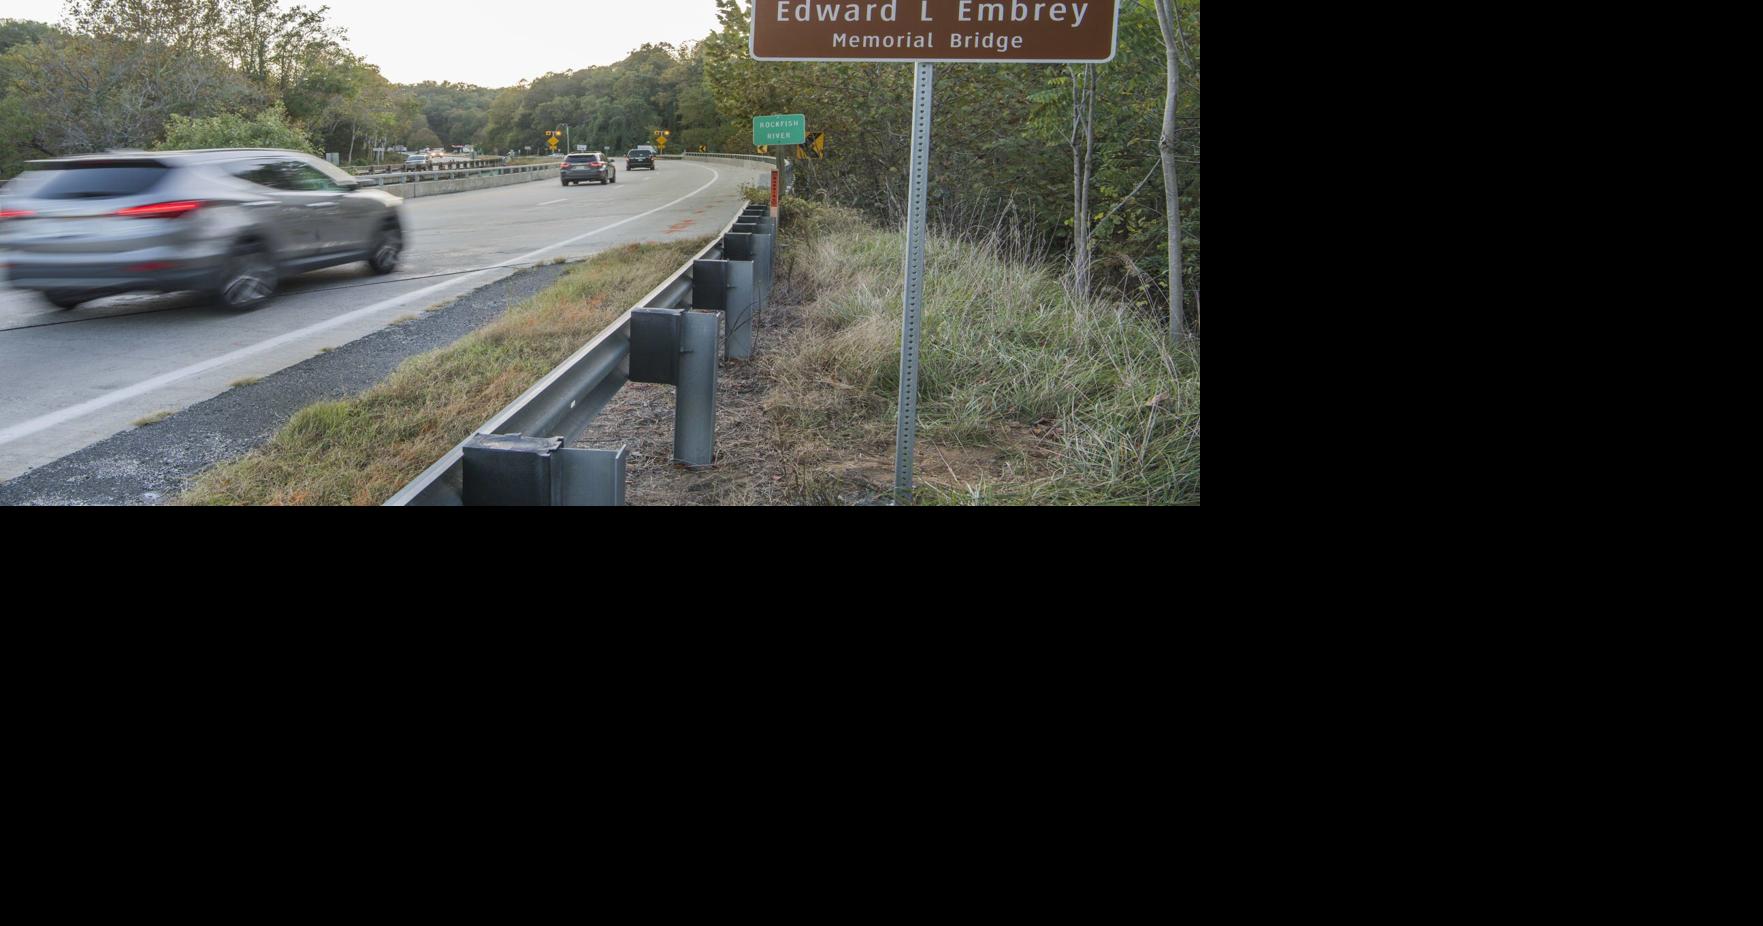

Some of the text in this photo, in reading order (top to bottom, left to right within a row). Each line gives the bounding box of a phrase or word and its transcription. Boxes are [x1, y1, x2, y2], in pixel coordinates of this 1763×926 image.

[776, 0, 1089, 28] Edward L Embrey
[832, 32, 1023, 52] Memorial Bridge
[760, 120, 799, 128] ROCKFISH
